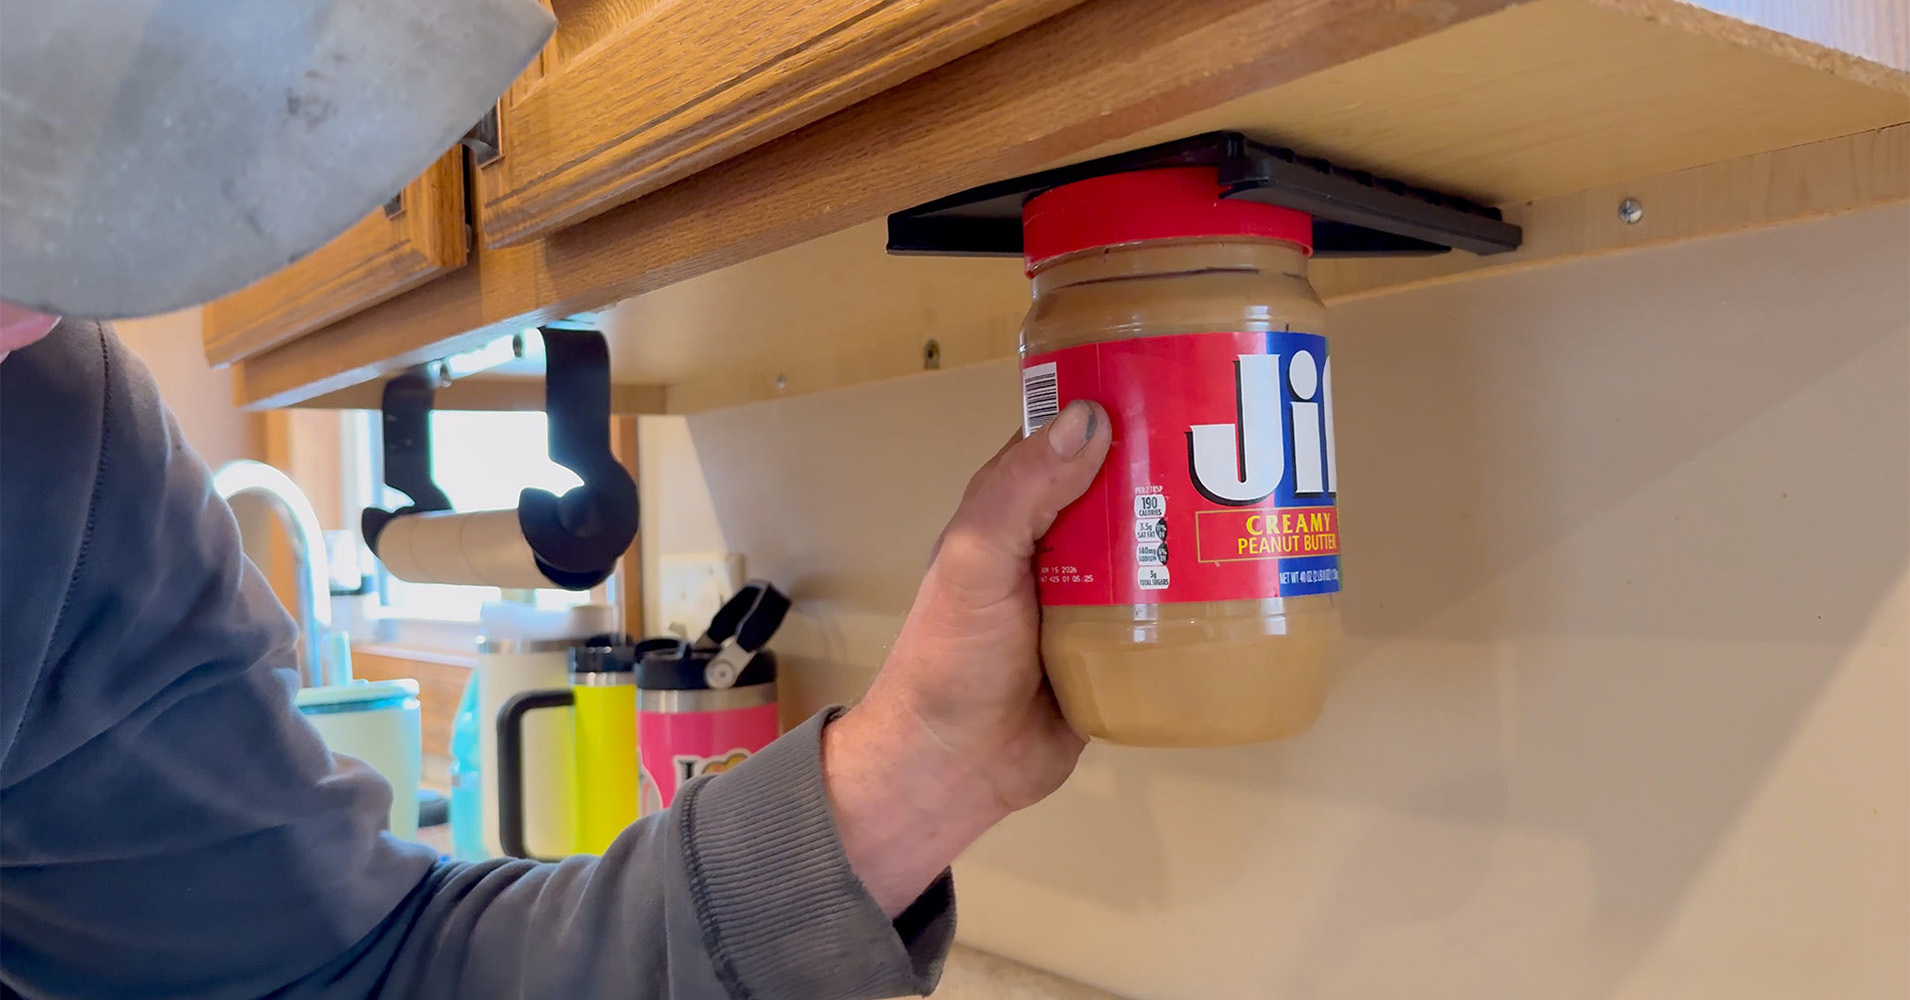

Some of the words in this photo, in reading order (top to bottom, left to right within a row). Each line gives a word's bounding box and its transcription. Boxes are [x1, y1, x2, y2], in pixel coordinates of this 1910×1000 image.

[1185, 349, 1337, 506] Ji
[1141, 496, 1158, 510] 190
[1139, 509, 1162, 517] CALORIES
[1246, 512, 1331, 536] CREAMY
[1238, 535, 1300, 555] PEANUT
[1280, 571, 1290, 585] NET
[1290, 571, 1299, 584] WT
